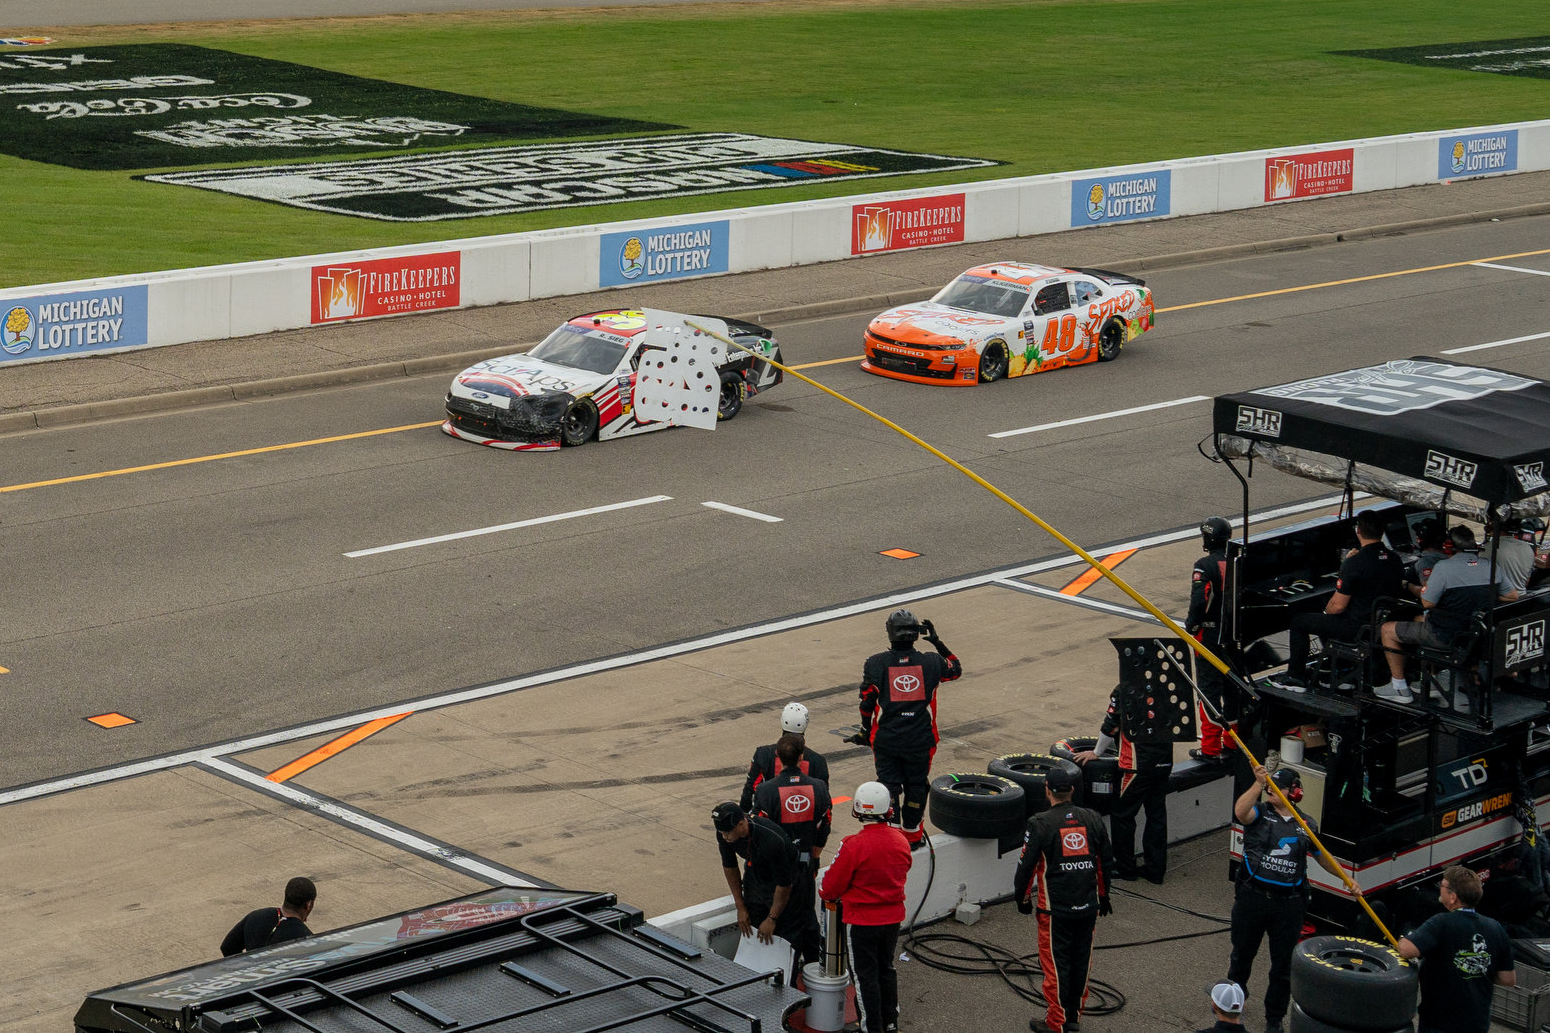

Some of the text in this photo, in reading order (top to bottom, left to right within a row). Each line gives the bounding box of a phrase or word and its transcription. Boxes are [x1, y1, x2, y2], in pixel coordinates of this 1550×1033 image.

[1468, 136, 1506, 153] MICHIGAN
[309, 146, 759, 188] CUP SERIES
[1467, 152, 1506, 171] LOTTERY
[440, 166, 780, 207] NASCAR
[1108, 178, 1157, 197] MICHIGAN
[1107, 195, 1156, 217] LOTTERY
[648, 229, 711, 253] MICHIGAN
[902, 227, 954, 239] CASINO HOTEL
[647, 249, 710, 276] LOTTERY
[377, 290, 446, 305] CASINO HOTEL
[388, 300, 436, 311] BATTLE CREEK
[38, 295, 123, 324] MICHIGAN
[38, 318, 123, 350] LOTTERY
[607, 335, 625, 343] SIEG
[1041, 314, 1077, 355] 48
[876, 343, 925, 357] CAMARO
[1451, 763, 1488, 789] TD
[1458, 792, 1513, 823] GEARWREN
[1060, 861, 1094, 871] TOYOTA
